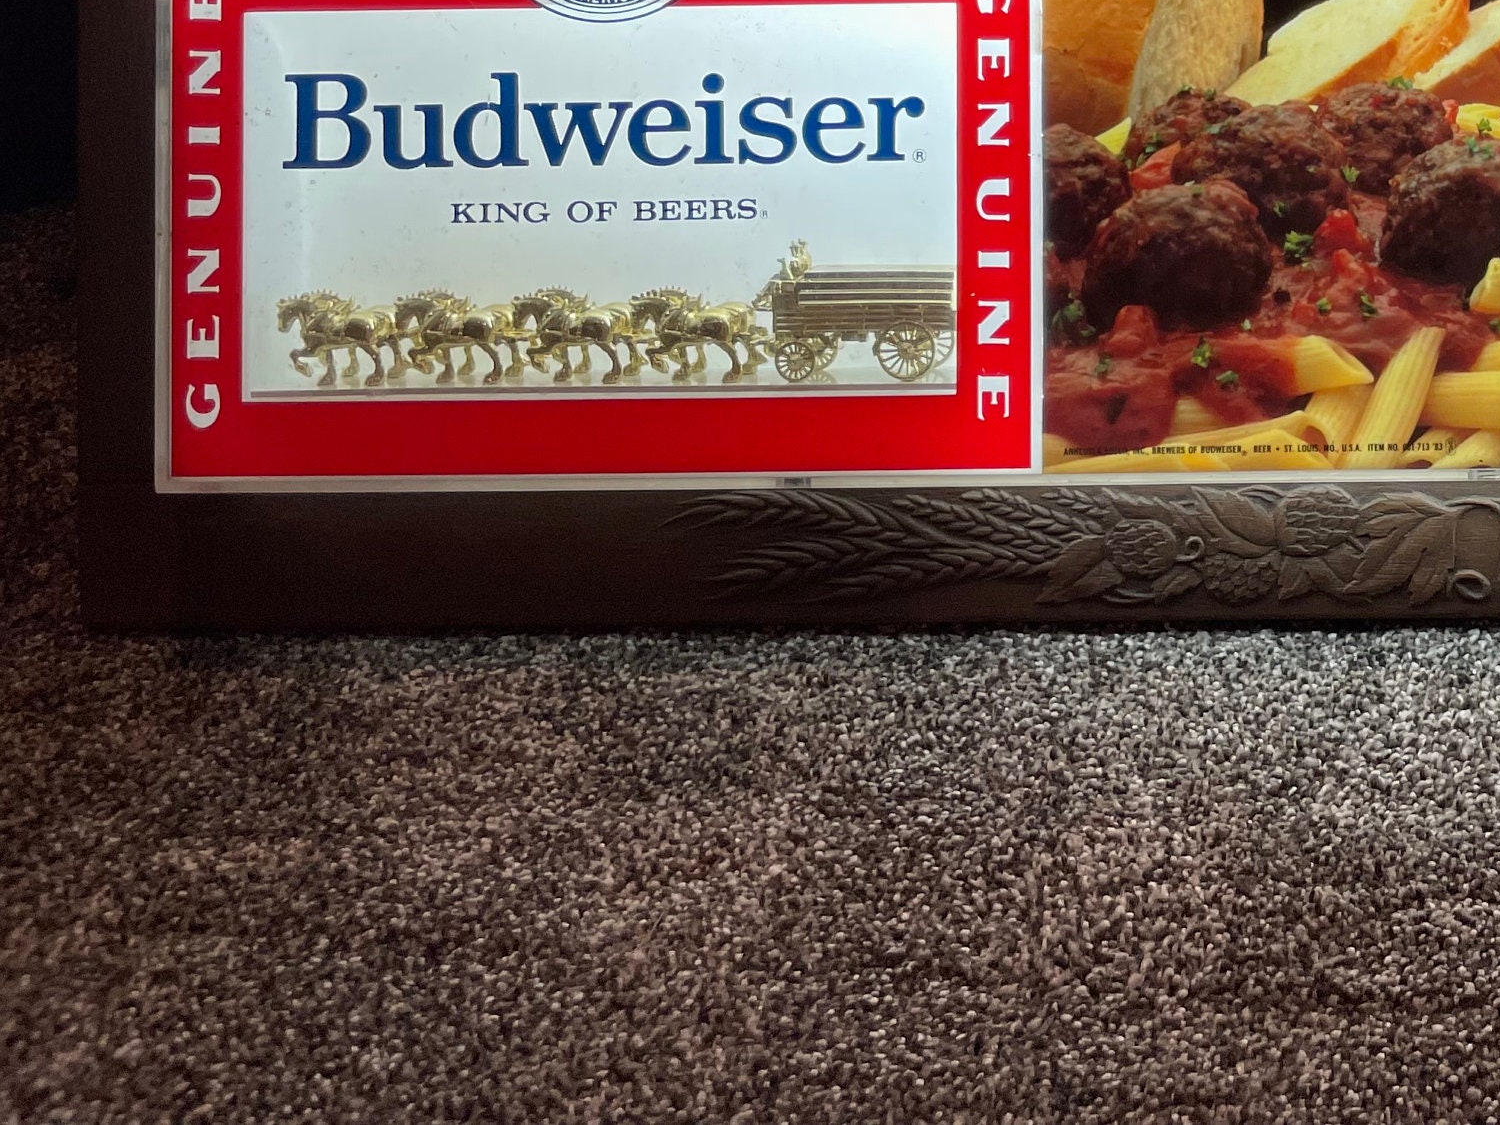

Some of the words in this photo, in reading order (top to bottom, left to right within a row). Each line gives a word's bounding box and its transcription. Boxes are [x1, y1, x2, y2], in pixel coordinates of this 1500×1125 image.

[450, 201, 551, 224] KING
[567, 200, 617, 223] OF
[1152, 446, 1185, 455] BREWERS
[1188, 445, 1197, 454] OF
[1253, 444, 1272, 453] BEER
[1368, 443, 1385, 452] ITEM
